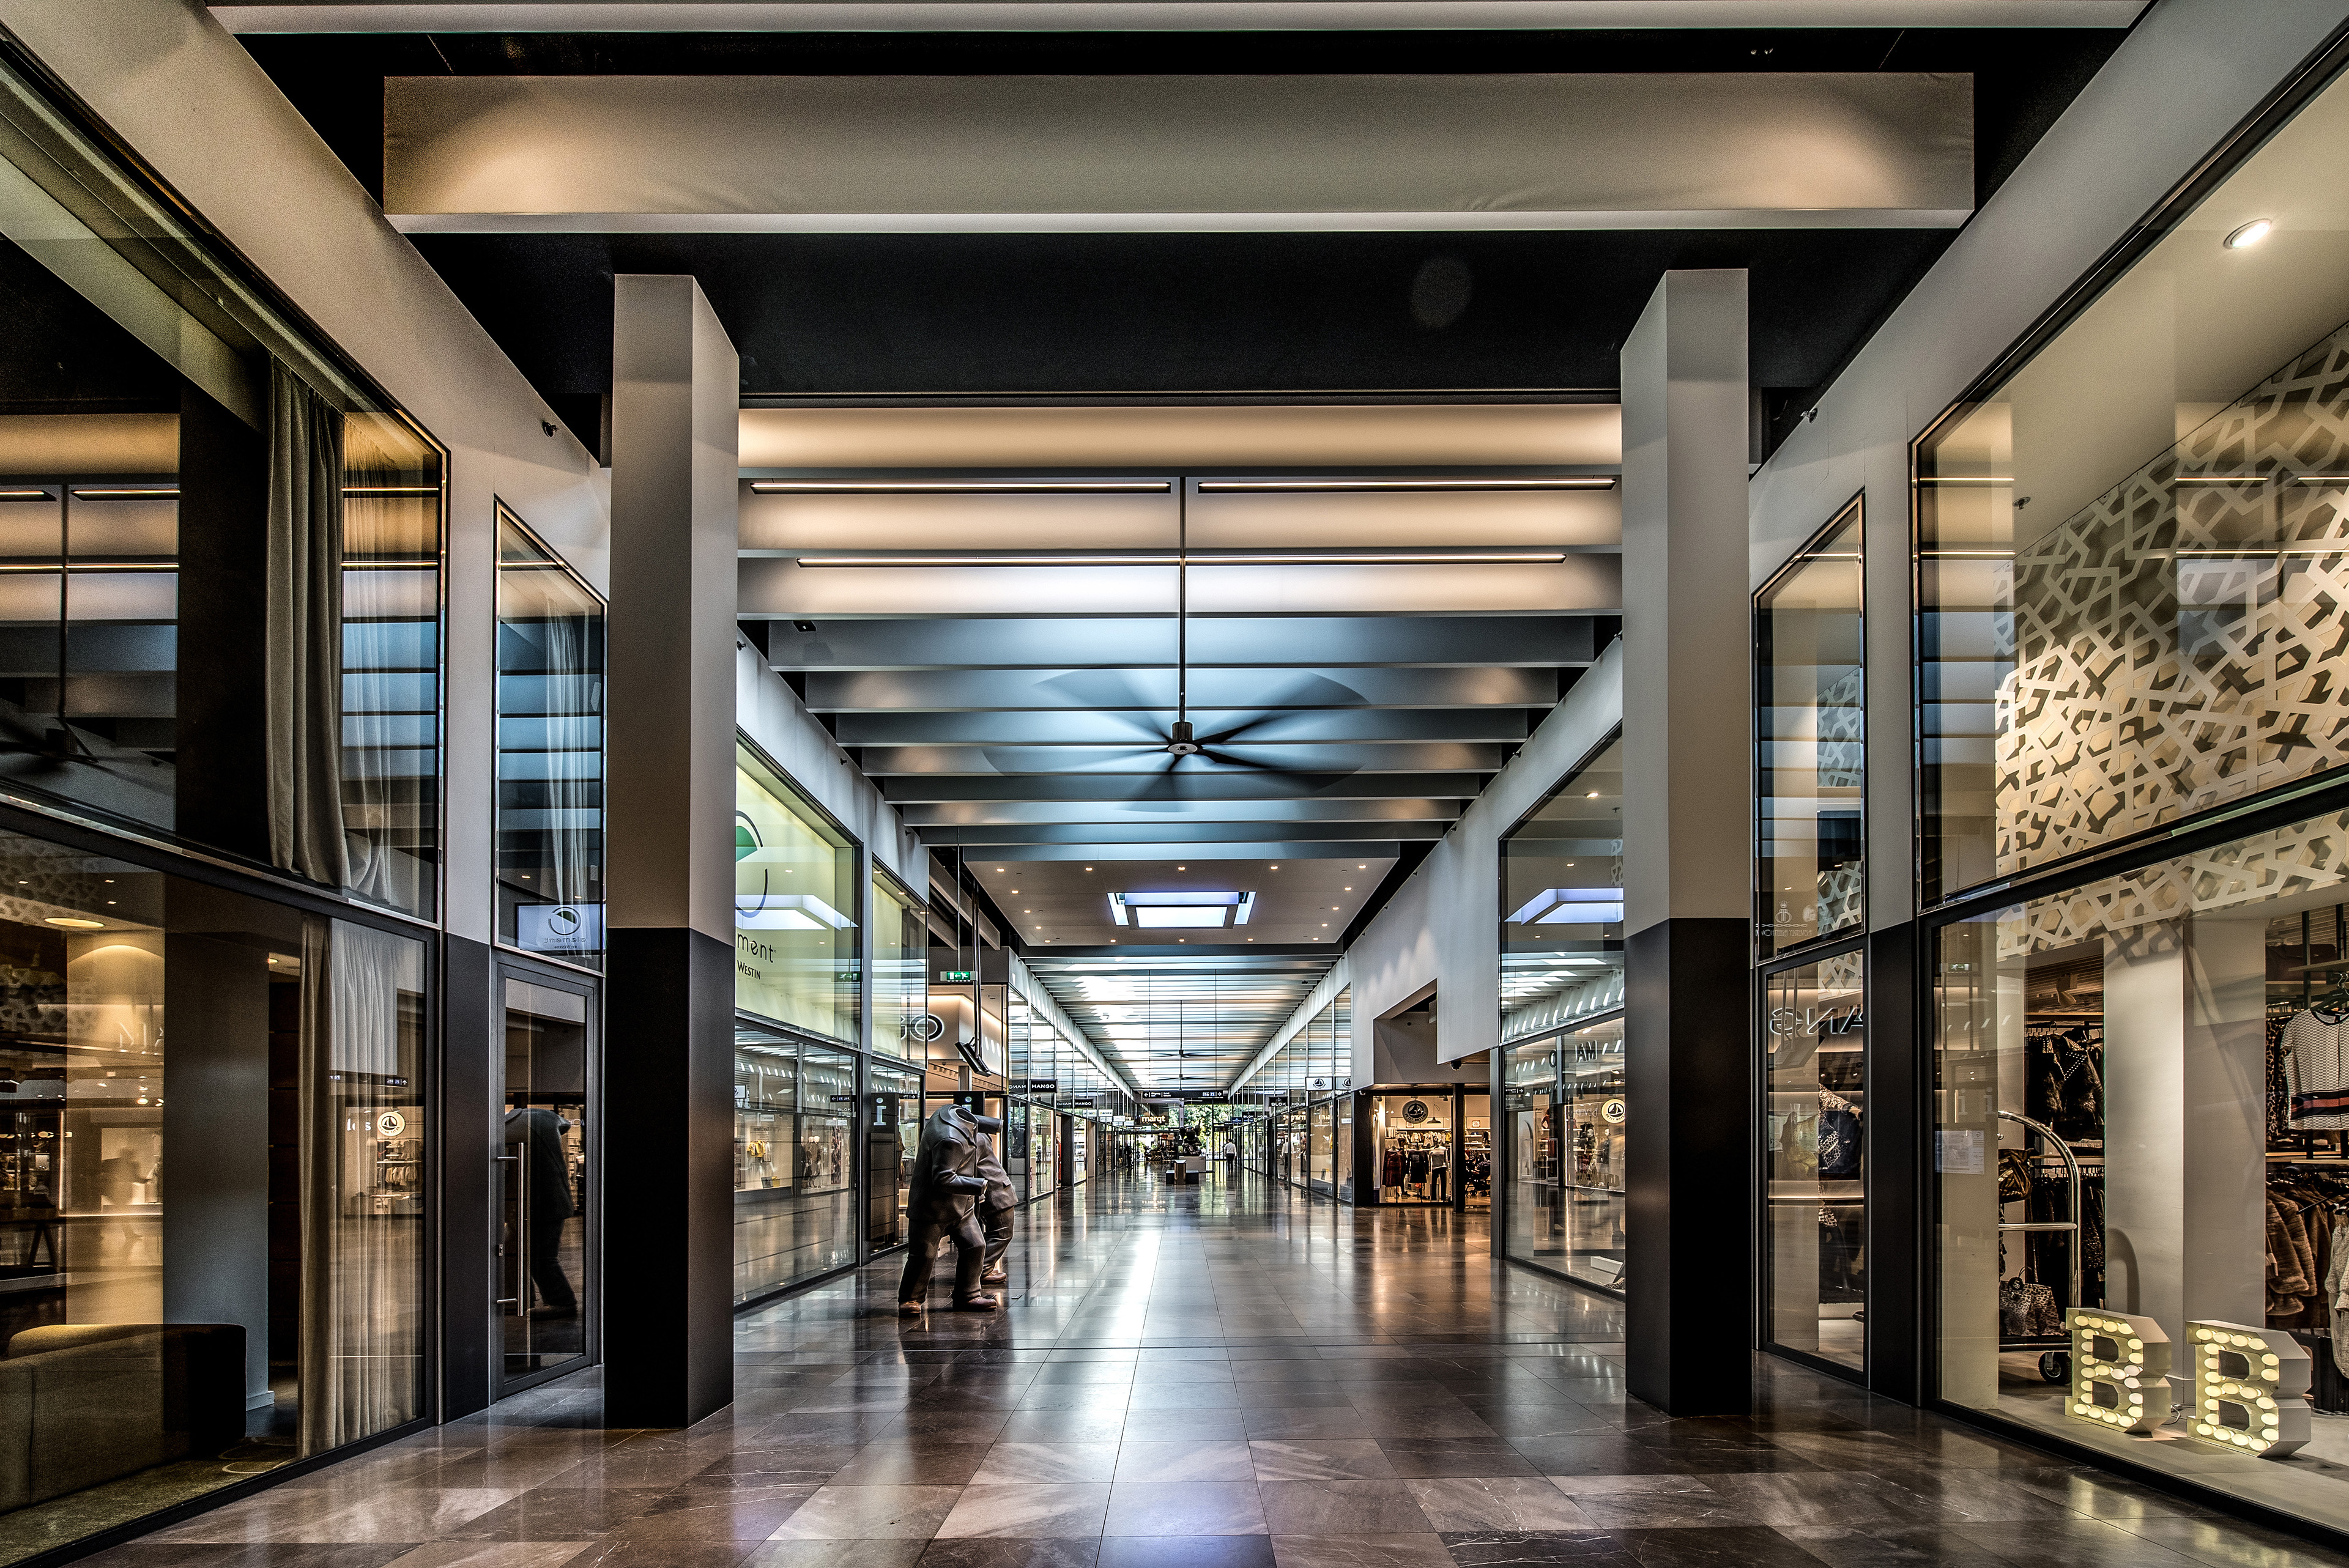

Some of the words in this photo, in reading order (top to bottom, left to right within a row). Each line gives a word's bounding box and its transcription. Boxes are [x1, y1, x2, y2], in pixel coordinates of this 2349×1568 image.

[737, 960, 761, 980] WESTIN
[1141, 1115, 1166, 1123] marqt
[2065, 1307, 2164, 1433] B
[2186, 1320, 2303, 1457] B
